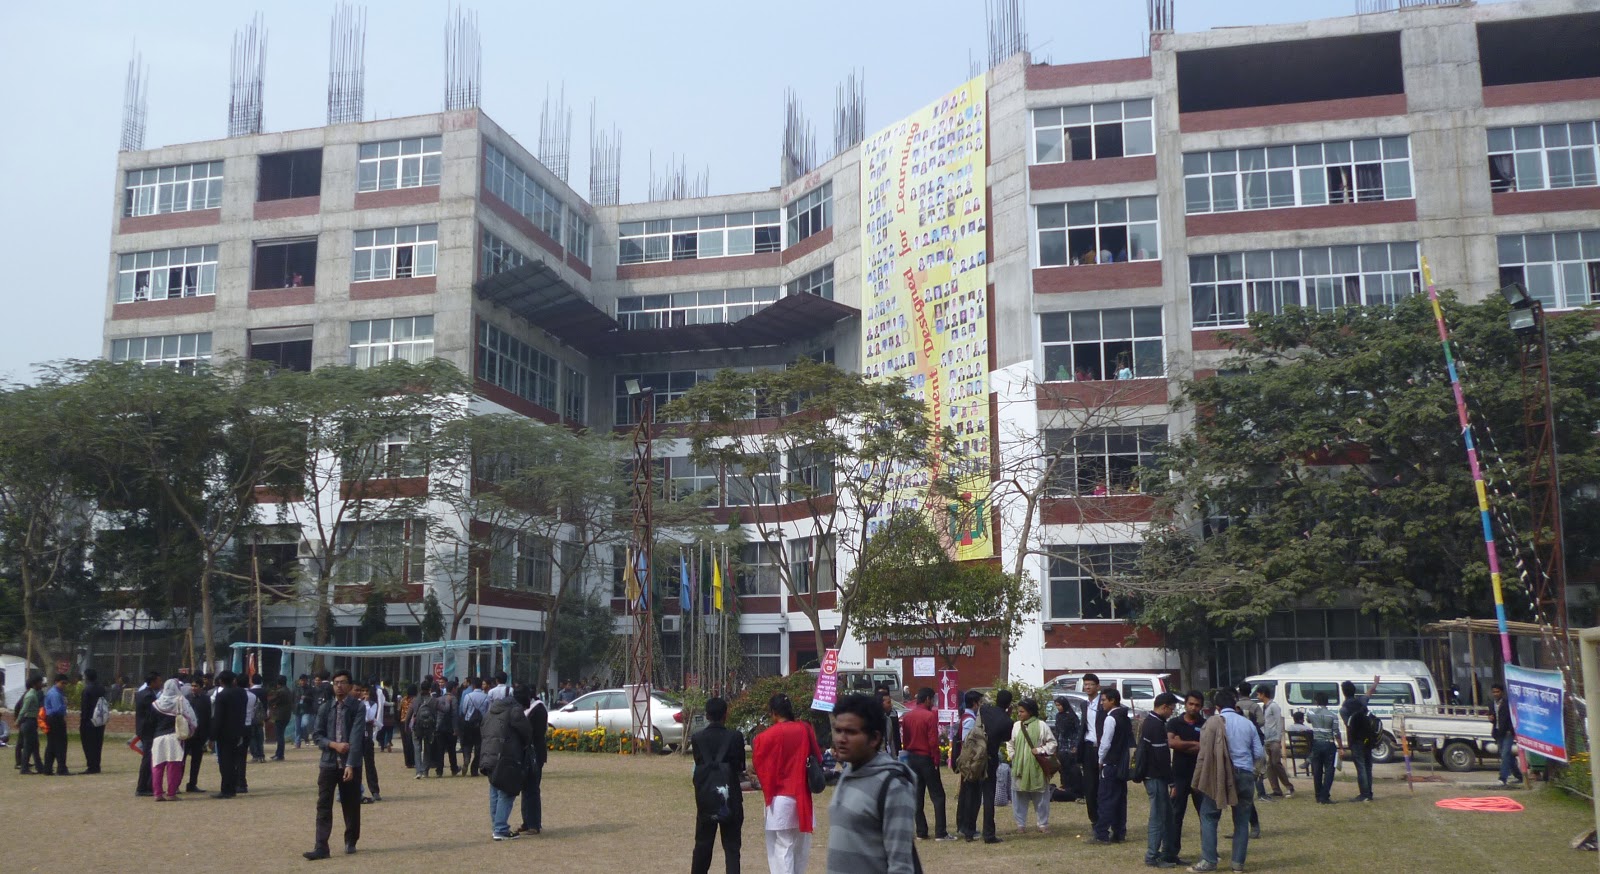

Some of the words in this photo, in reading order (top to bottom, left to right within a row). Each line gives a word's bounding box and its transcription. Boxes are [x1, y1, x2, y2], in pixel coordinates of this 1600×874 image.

[896, 122, 920, 214] Learning
[899, 229, 912, 257] for
[903, 266, 934, 358] Designed
[921, 646, 934, 656] and
[936, 643, 975, 657] Tehnlogy
